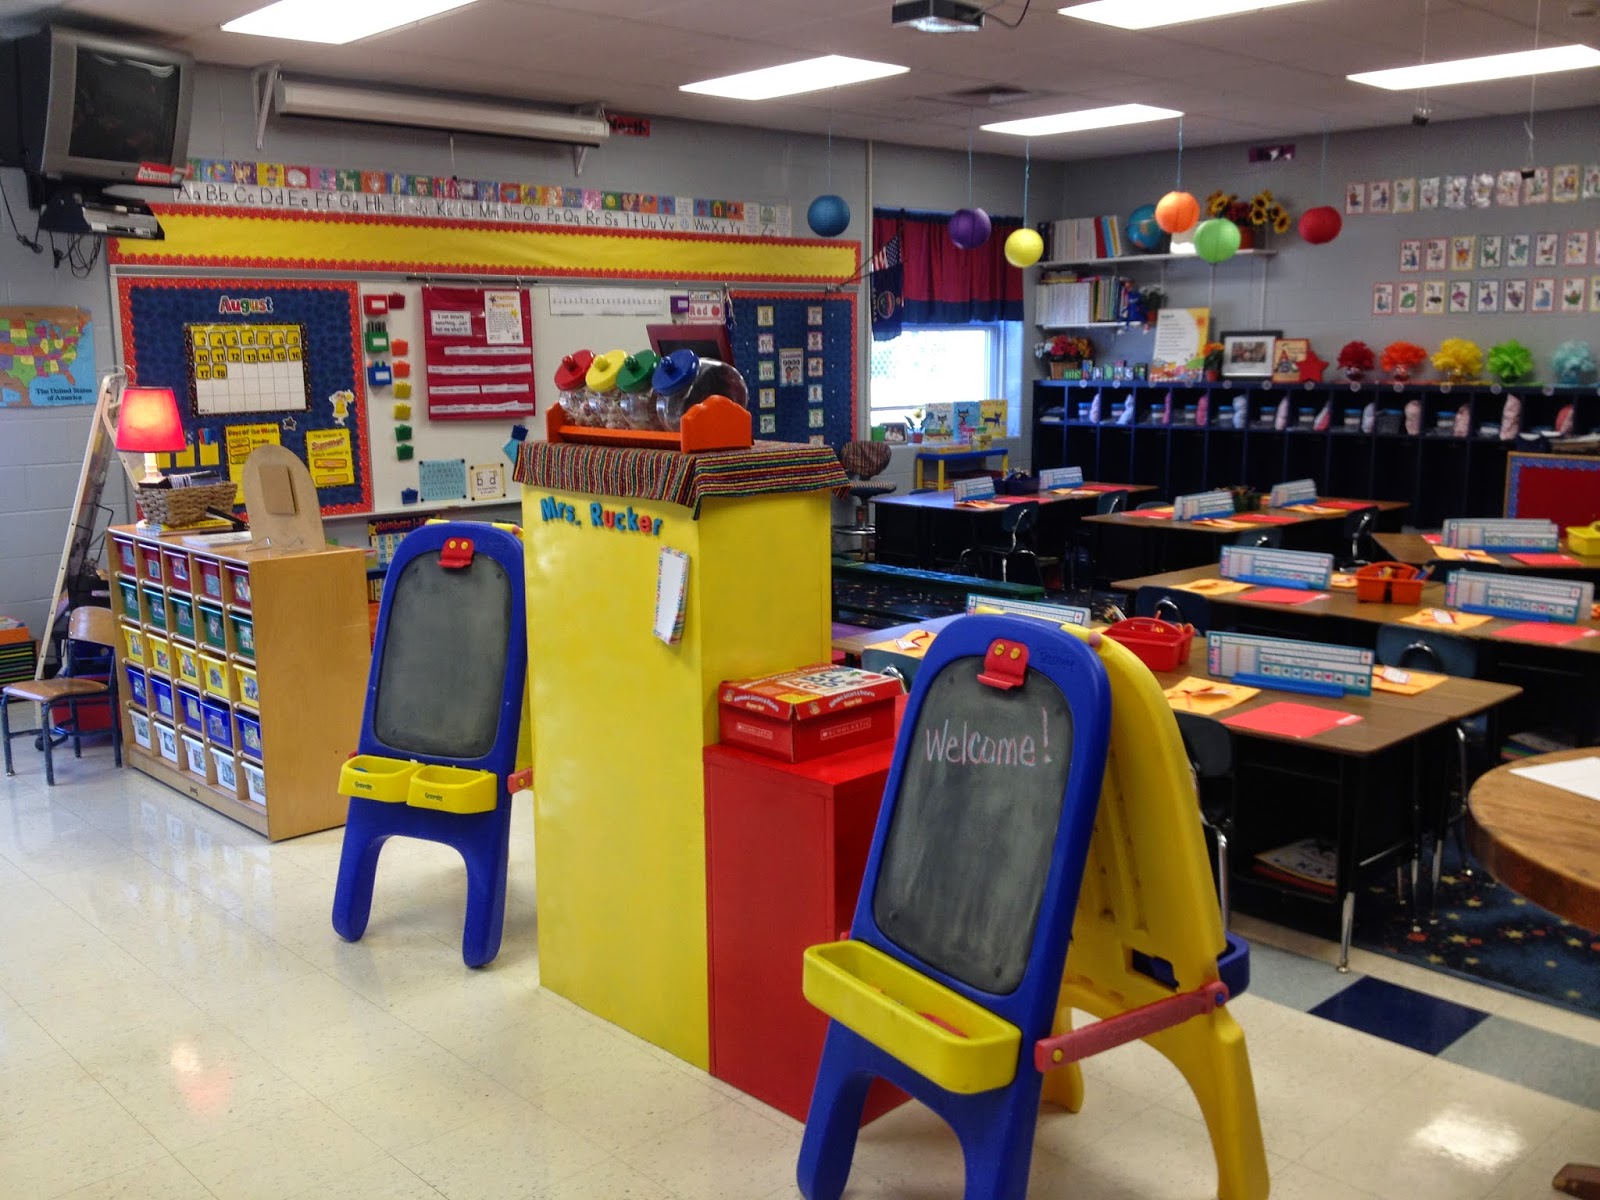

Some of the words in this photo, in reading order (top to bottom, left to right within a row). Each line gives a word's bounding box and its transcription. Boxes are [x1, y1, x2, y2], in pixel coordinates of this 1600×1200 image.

[219, 295, 273, 315] August
[476, 471, 484, 486] b
[489, 470, 497, 485] d
[540, 496, 581, 526] Mrs.
[590, 502, 663, 536] Rucker
[828, 719, 870, 736] SCHOLASTIC
[925, 707, 1052, 767] Welcome!
